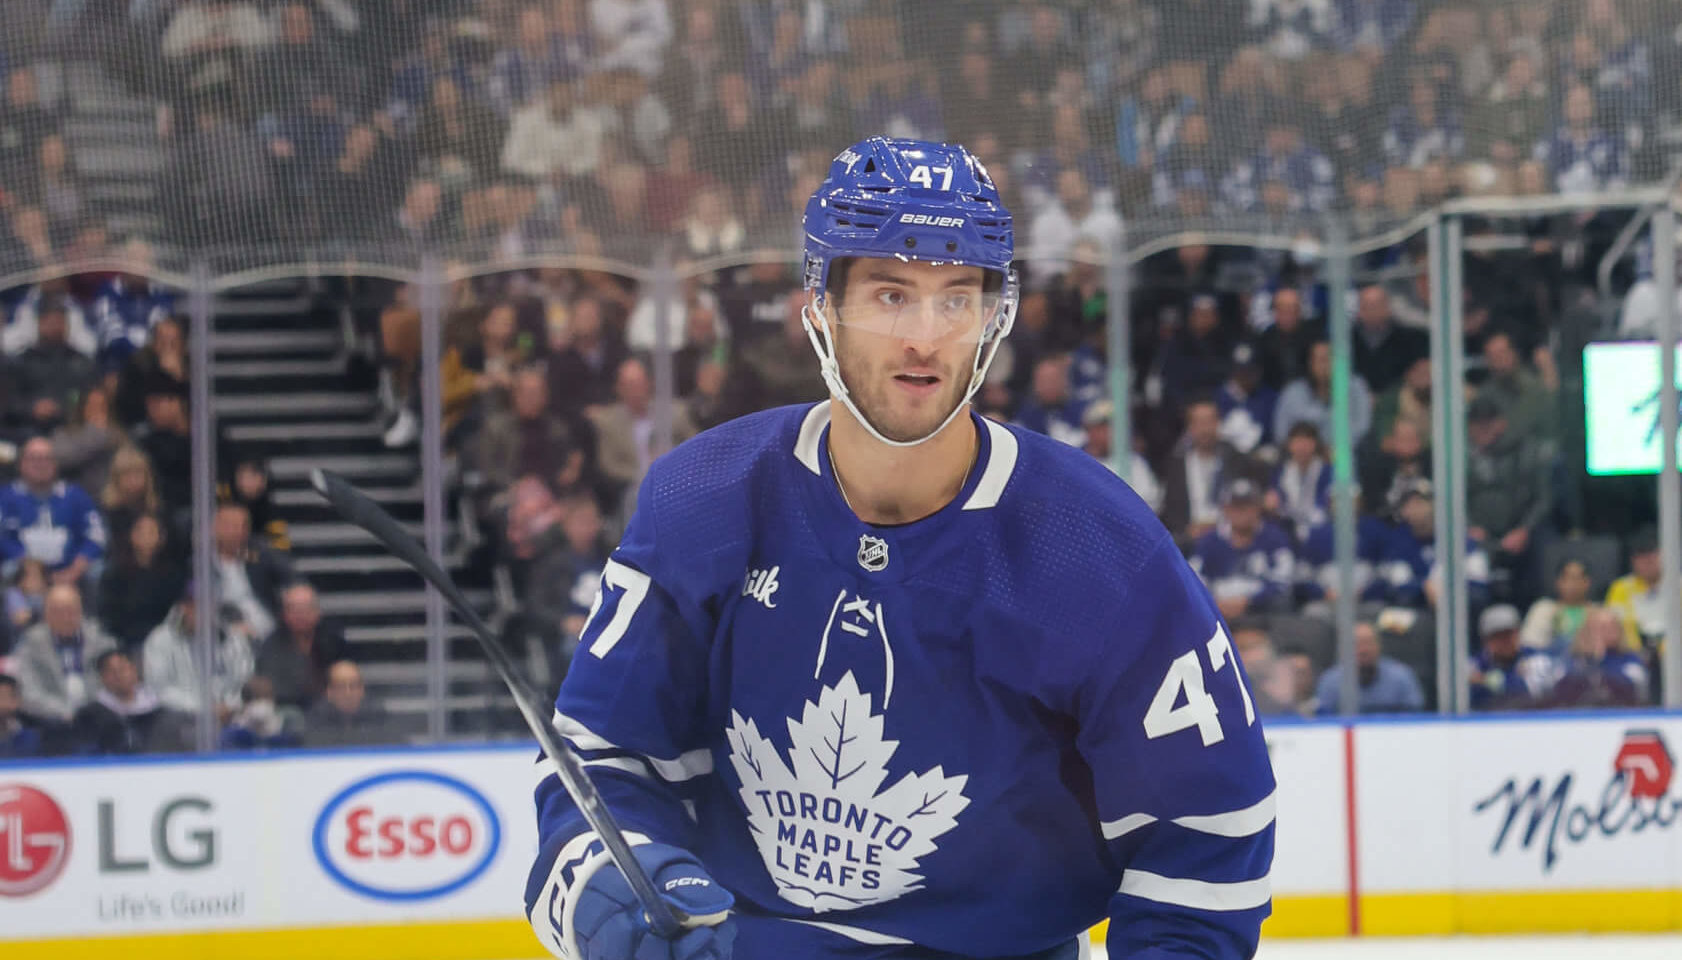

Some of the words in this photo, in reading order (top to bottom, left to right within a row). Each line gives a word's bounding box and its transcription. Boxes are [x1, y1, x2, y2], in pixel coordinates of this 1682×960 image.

[909, 165, 954, 191] 47
[899, 212, 966, 228] BAUER
[579, 557, 652, 660] 7
[742, 566, 780, 608] ilk
[98, 797, 217, 873] LG
[344, 806, 476, 861] Esso
[755, 790, 913, 851] TORONTO
[777, 819, 883, 866] MAPLE
[776, 845, 881, 890] LEAFS
